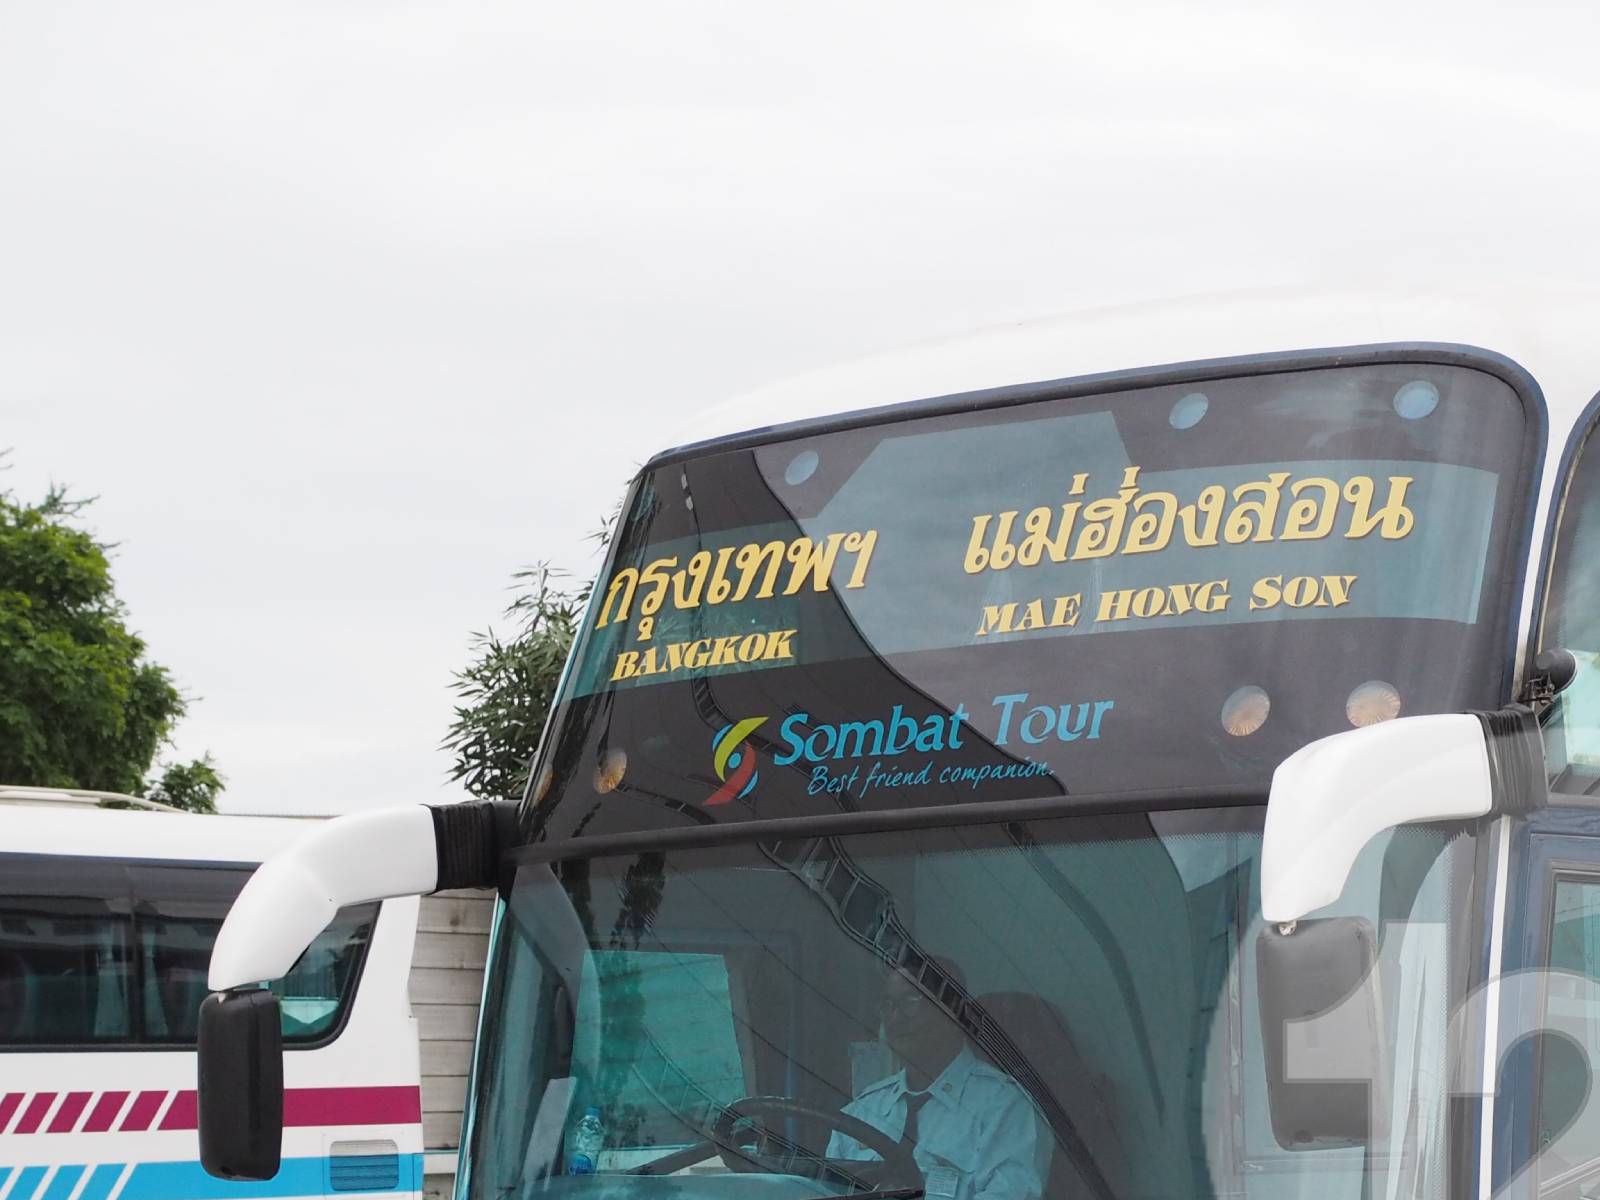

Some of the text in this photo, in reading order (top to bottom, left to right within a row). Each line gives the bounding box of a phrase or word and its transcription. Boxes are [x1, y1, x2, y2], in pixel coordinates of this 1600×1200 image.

[964, 466, 1414, 574] แม่ฮ่องสอน
[595, 529, 878, 641] กรุงเทพฯ
[976, 575, 1357, 636] MAE HONG SON
[610, 629, 799, 682] BANGKOK
[774, 693, 1113, 767] Sombat Tour
[807, 765, 860, 796] Best
[860, 759, 931, 799] friend
